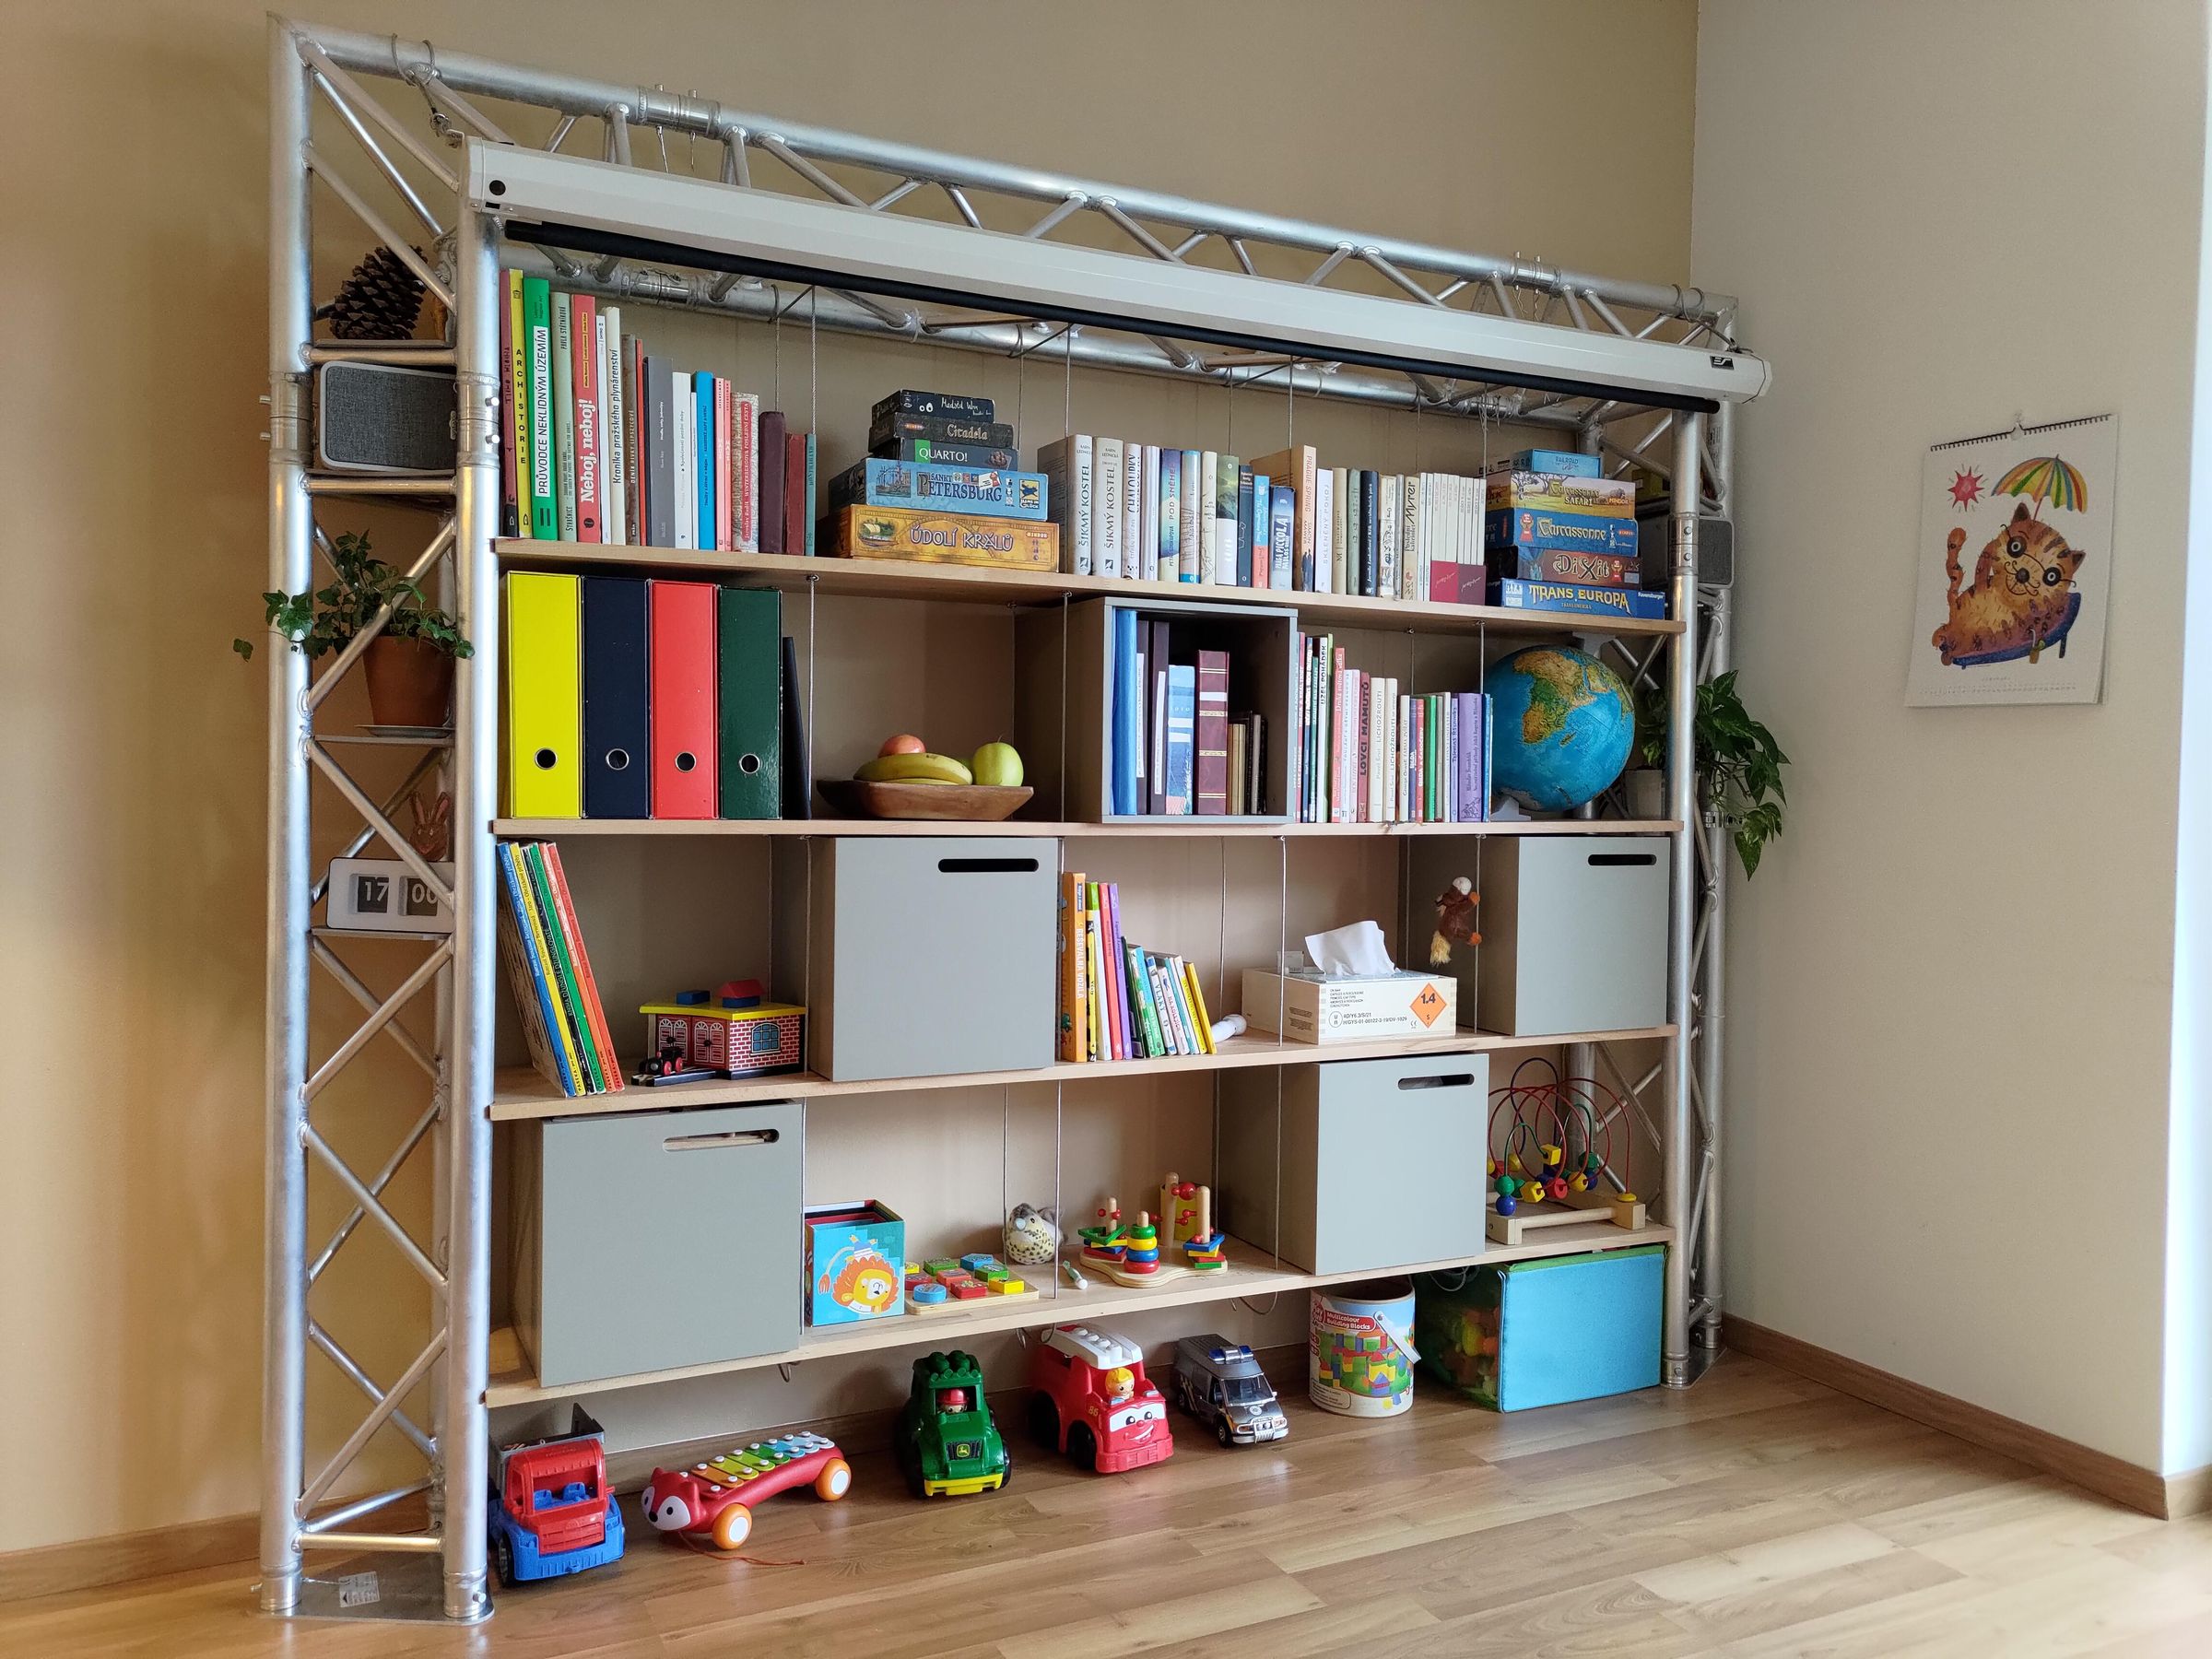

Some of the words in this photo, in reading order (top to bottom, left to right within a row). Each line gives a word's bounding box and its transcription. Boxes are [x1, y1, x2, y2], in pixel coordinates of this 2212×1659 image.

[536, 329, 547, 372] ÚZEMÍM
[609, 348, 621, 402] plynárenství
[515, 349, 526, 465] ARCHISTORIE
[536, 376, 547, 436] NEKLIDNÝM
[579, 399, 595, 449] neboj!
[611, 405, 623, 448] pražského
[947, 423, 988, 440] Citadela
[535, 440, 547, 494] PRŮVODCE
[611, 451, 621, 484] Kronika
[919, 447, 968, 462] QUARTO!
[580, 452, 597, 502] Neboj,
[917, 472, 1002, 501] PETERSBURG
[931, 473, 952, 482] SANKT
[1080, 465, 1089, 507] KOSTEL
[1106, 466, 1114, 509] KOSTEL
[1564, 496, 1593, 506] SAFARI
[911, 525, 958, 547] ÚDOLÍ
[963, 532, 1013, 552] KRÁLŮ
[1078, 511, 1088, 547] ŠIKMÝ
[1103, 513, 1114, 548] ŠIKMÝ
[1273, 518, 1288, 553] PICCOLA
[1537, 518, 1606, 540] Carcassonne
[1528, 584, 1573, 604] TRANS
[1578, 589, 1632, 617] EUROPA
[1360, 682, 1369, 735] MAMUTŮ
[1359, 742, 1368, 776] LOVCI
[365, 881, 389, 901] 17
[1155, 983, 1166, 1011] VLAKY
[1420, 993, 1436, 1004] 1.4
[572, 1069, 582, 1090] PASEKA
[1327, 1312, 1359, 1323] Multicolour
[1327, 1318, 1349, 1328] Building
[1088, 1406, 1099, 1417] 86
